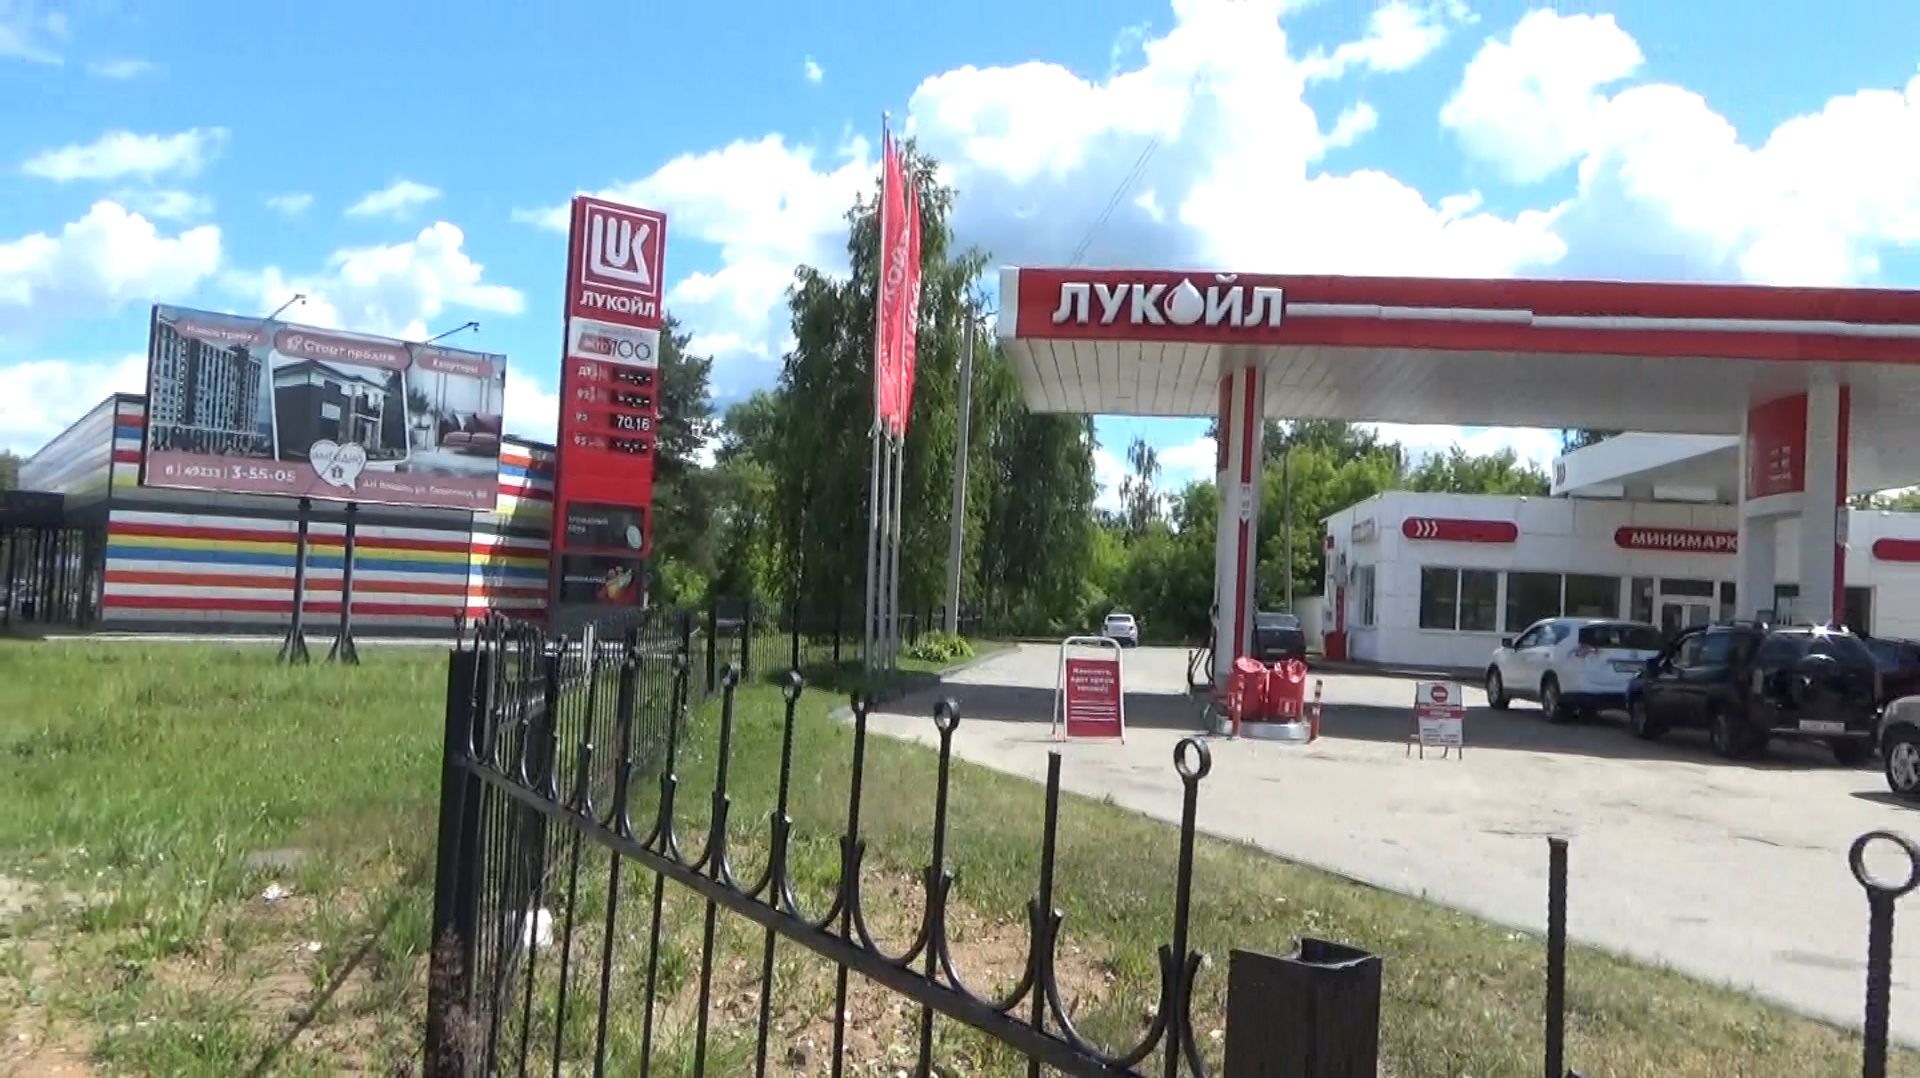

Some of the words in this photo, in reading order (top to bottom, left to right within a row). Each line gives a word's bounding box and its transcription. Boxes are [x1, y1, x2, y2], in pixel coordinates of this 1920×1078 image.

[580, 290, 656, 319] ЛУКОЙЛ
[1052, 273, 1284, 327] ЛУКОЙЛ
[610, 339, 652, 361] 100
